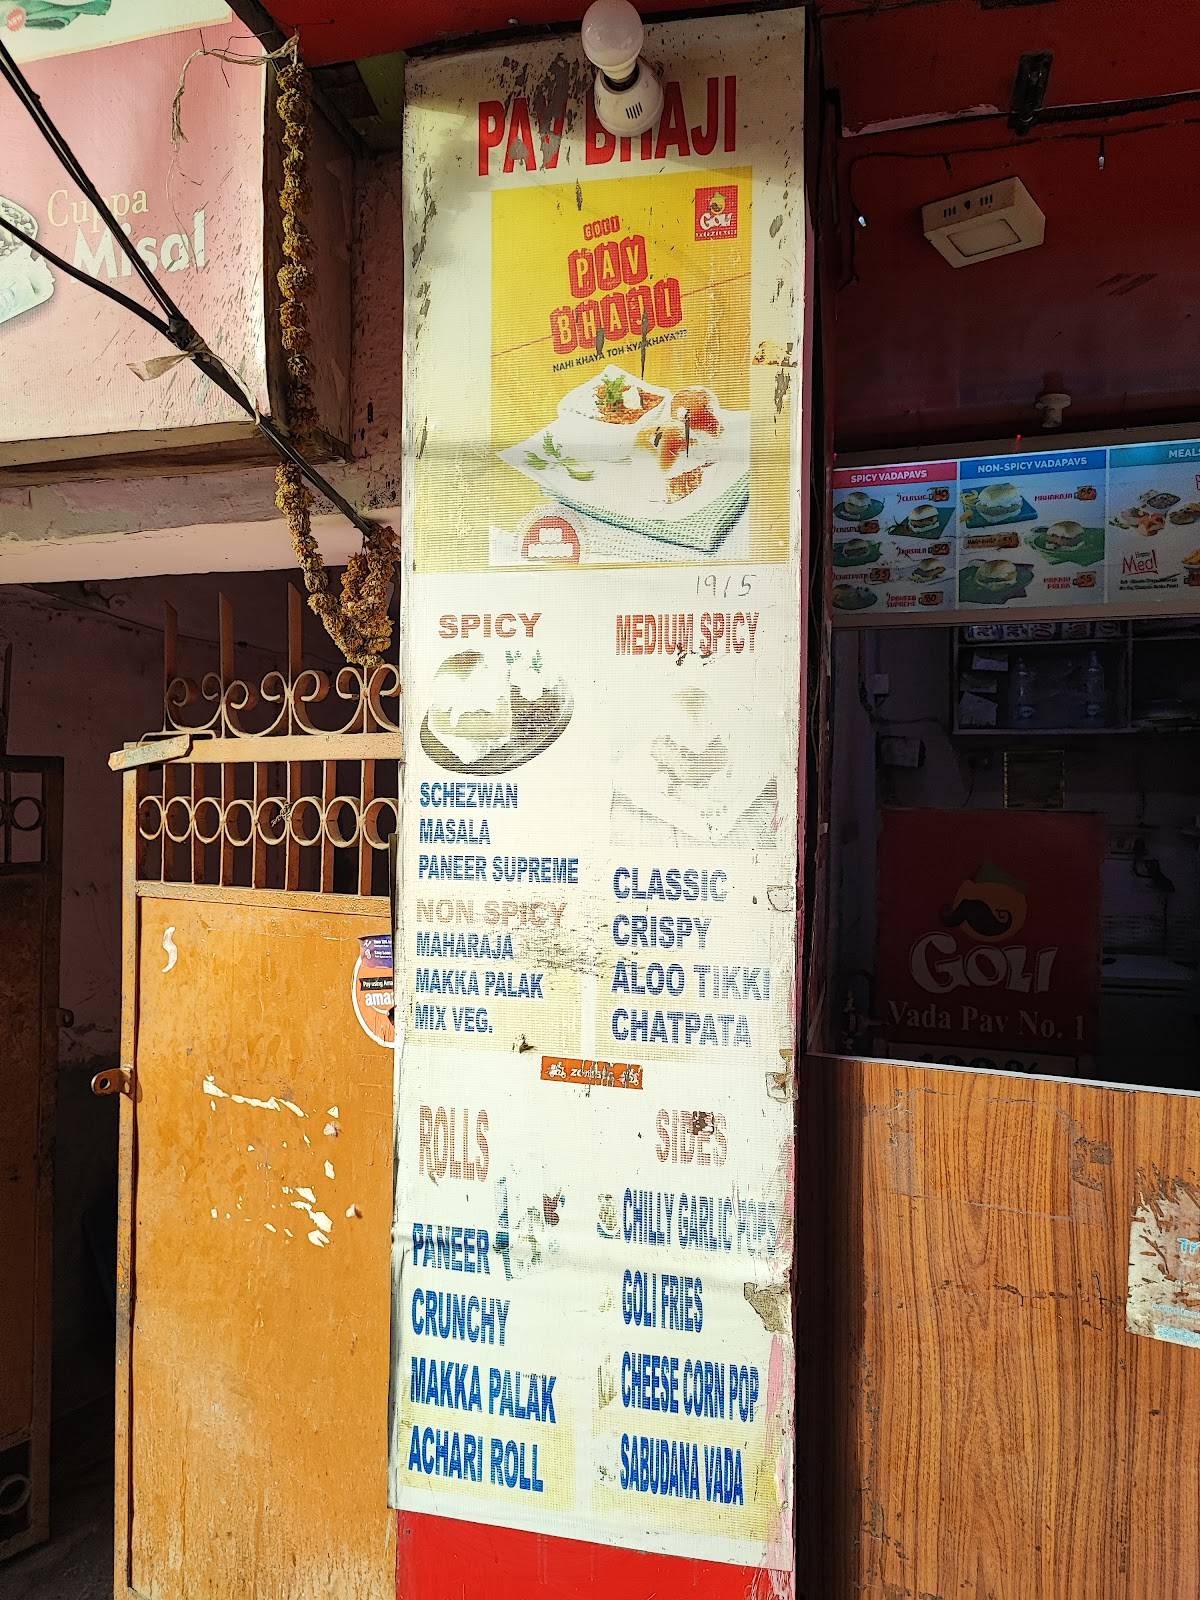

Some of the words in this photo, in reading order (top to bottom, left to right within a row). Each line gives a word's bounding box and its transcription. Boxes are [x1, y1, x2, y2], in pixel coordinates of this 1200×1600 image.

[572, 240, 644, 295] PAV
[553, 281, 678, 350] BHAJI
[553, 360, 574, 373] NAHI
[575, 352, 605, 366] KHAYA
[606, 346, 625, 359] TOH
[851, 473, 877, 483] SPICY
[878, 470, 928, 481] VADAPAVS
[977, 462, 1033, 474] NON-SPICY
[1034, 457, 1088, 469] VADAPAVS
[438, 612, 543, 639] SPICY
[615, 613, 694, 656] MEDIUM
[700, 611, 760, 656] SPICY
[419, 782, 519, 809] SCHEZWAN
[419, 818, 491, 845] MASALA
[418, 854, 487, 882] PANEER
[492, 855, 579, 884] SUPREME
[613, 866, 728, 902] CLASSIC
[416, 899, 474, 924] NON
[484, 900, 568, 928] SPICY
[612, 914, 712, 950] CRISPY
[416, 931, 514, 960] MAHARAJA
[910, 931, 1060, 995] GOLI
[365, 992, 394, 1007] ama
[415, 968, 479, 995] MAKKA
[484, 971, 544, 999] PALAK
[611, 961, 685, 997] ALOO
[693, 964, 770, 1000] TIKKI
[414, 1003, 447, 1031] MIX
[452, 1006, 494, 1034] VEG.
[611, 1008, 753, 1048] CHATPATA
[888, 999, 952, 1030] Vada
[960, 1004, 1009, 1034] Pav
[1018, 1009, 1064, 1041] No.
[1073, 1014, 1088, 1041] 1
[418, 1105, 490, 1182] ROLLS
[655, 1108, 728, 1167] SIDES
[623, 1187, 675, 1247] CHILLY
[678, 1192, 733, 1253] GARLIC
[412, 1222, 491, 1276] PANEER
[411, 1287, 511, 1347] CRUNCHY
[622, 1269, 657, 1328] GOLI
[660, 1274, 704, 1334] FRIES
[410, 1356, 482, 1412] MAKKA
[488, 1367, 557, 1424] PALAK
[621, 1350, 679, 1416] CHEESE
[683, 1358, 725, 1419] CORN
[729, 1363, 760, 1423] POP
[408, 1425, 484, 1483] ACHARI
[490, 1438, 544, 1493] ROLL
[620, 1433, 701, 1501] SABUDANA
[703, 1444, 744, 1505] VADA
